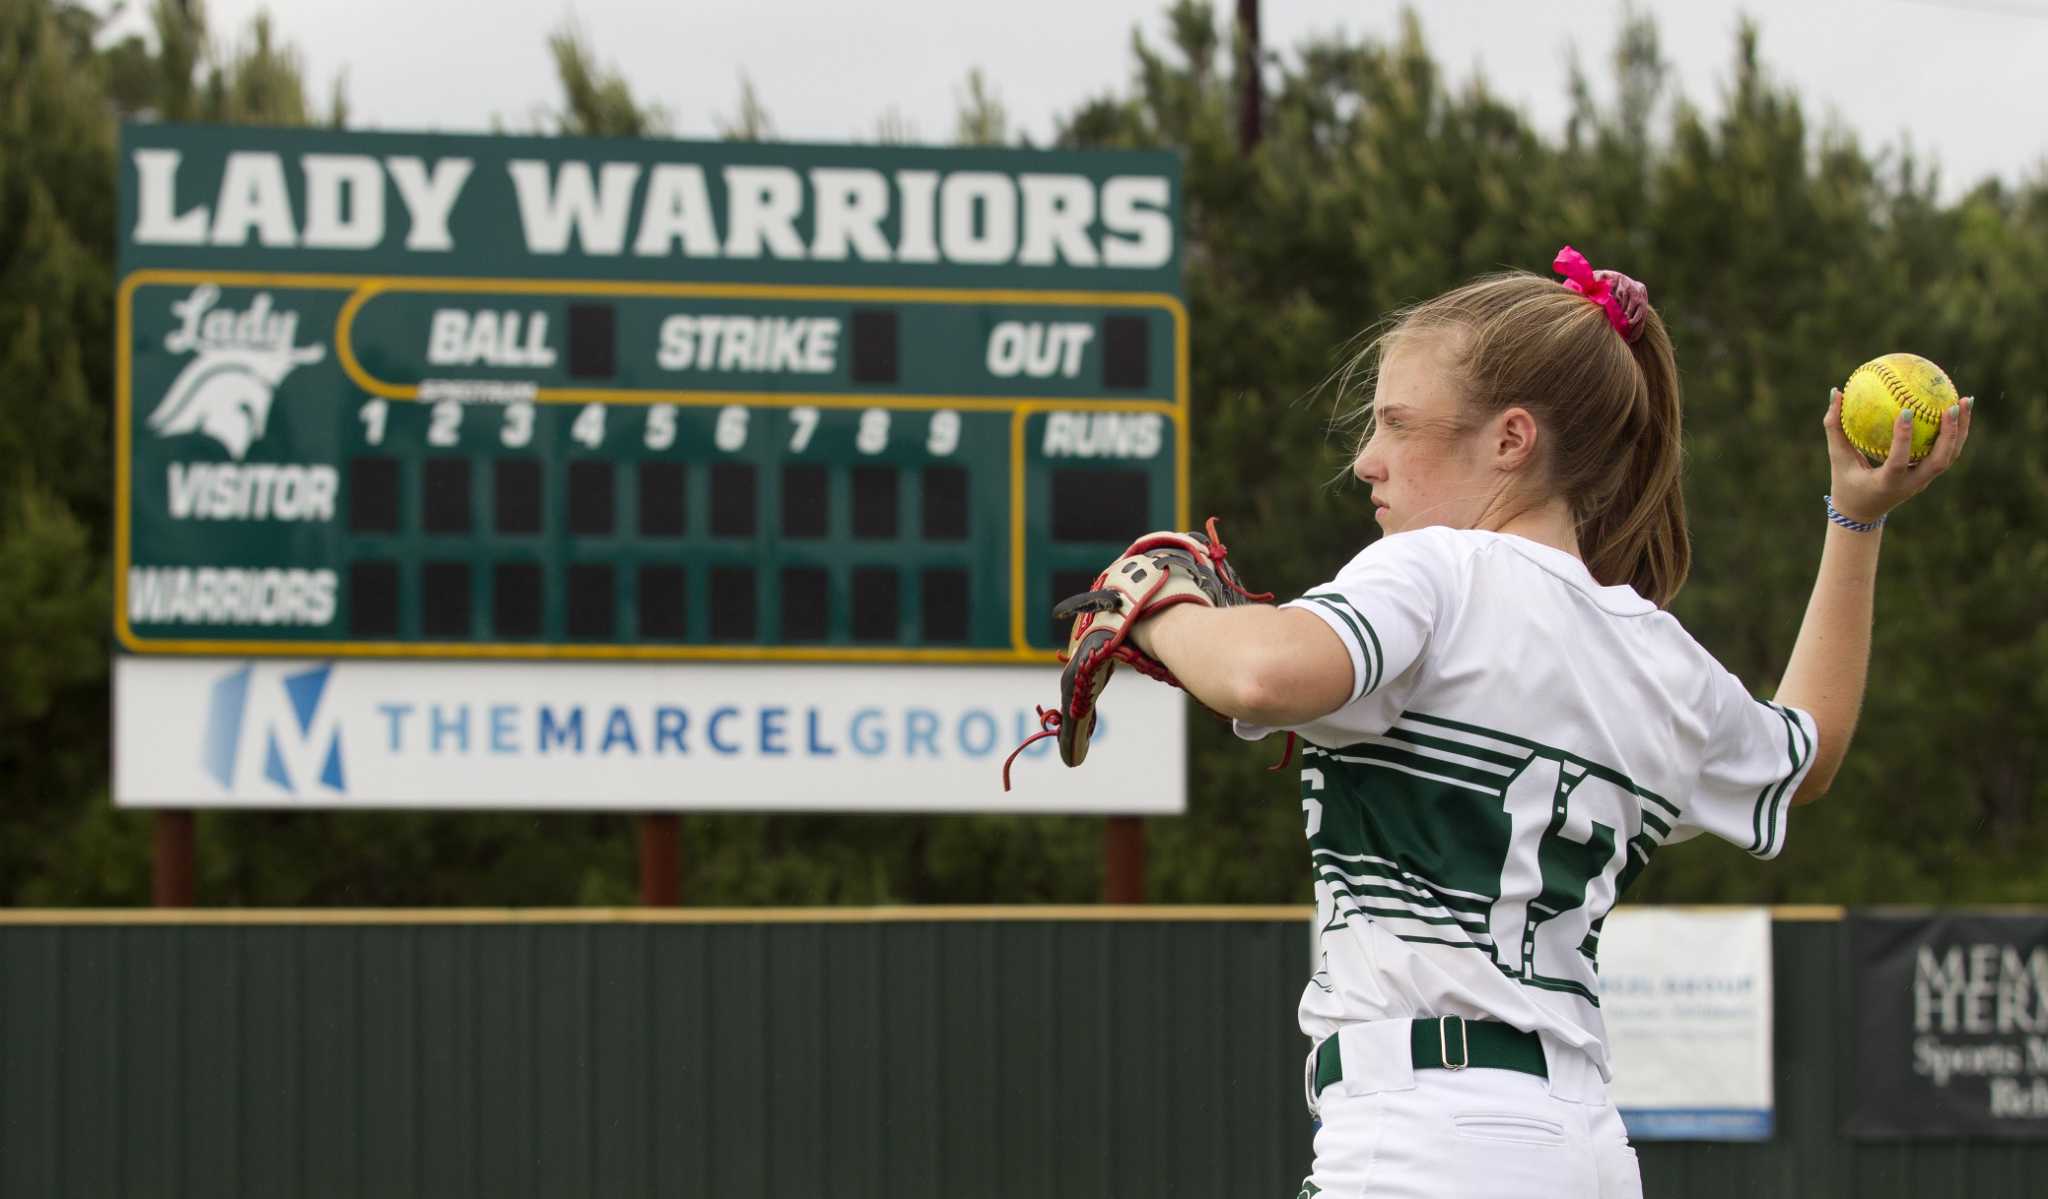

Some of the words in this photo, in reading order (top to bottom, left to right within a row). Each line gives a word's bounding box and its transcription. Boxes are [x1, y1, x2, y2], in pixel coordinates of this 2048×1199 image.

[132, 148, 474, 251] LADY
[508, 160, 1173, 268] WARRIORS
[164, 283, 326, 364] Lady
[427, 309, 556, 368] BALL
[656, 314, 841, 374] STRIKE
[986, 321, 1094, 379] OUT
[359, 399, 388, 446] 1
[427, 401, 462, 448] 2
[501, 401, 534, 448] 3
[570, 402, 606, 449] 4
[645, 404, 677, 451] 5
[715, 406, 749, 452] 6
[789, 407, 820, 454] 7
[857, 408, 890, 455] 8
[927, 409, 961, 456] 9
[1043, 411, 1163, 459] RUNS
[168, 463, 338, 521] VISITOR
[129, 567, 336, 625] WARRIORS
